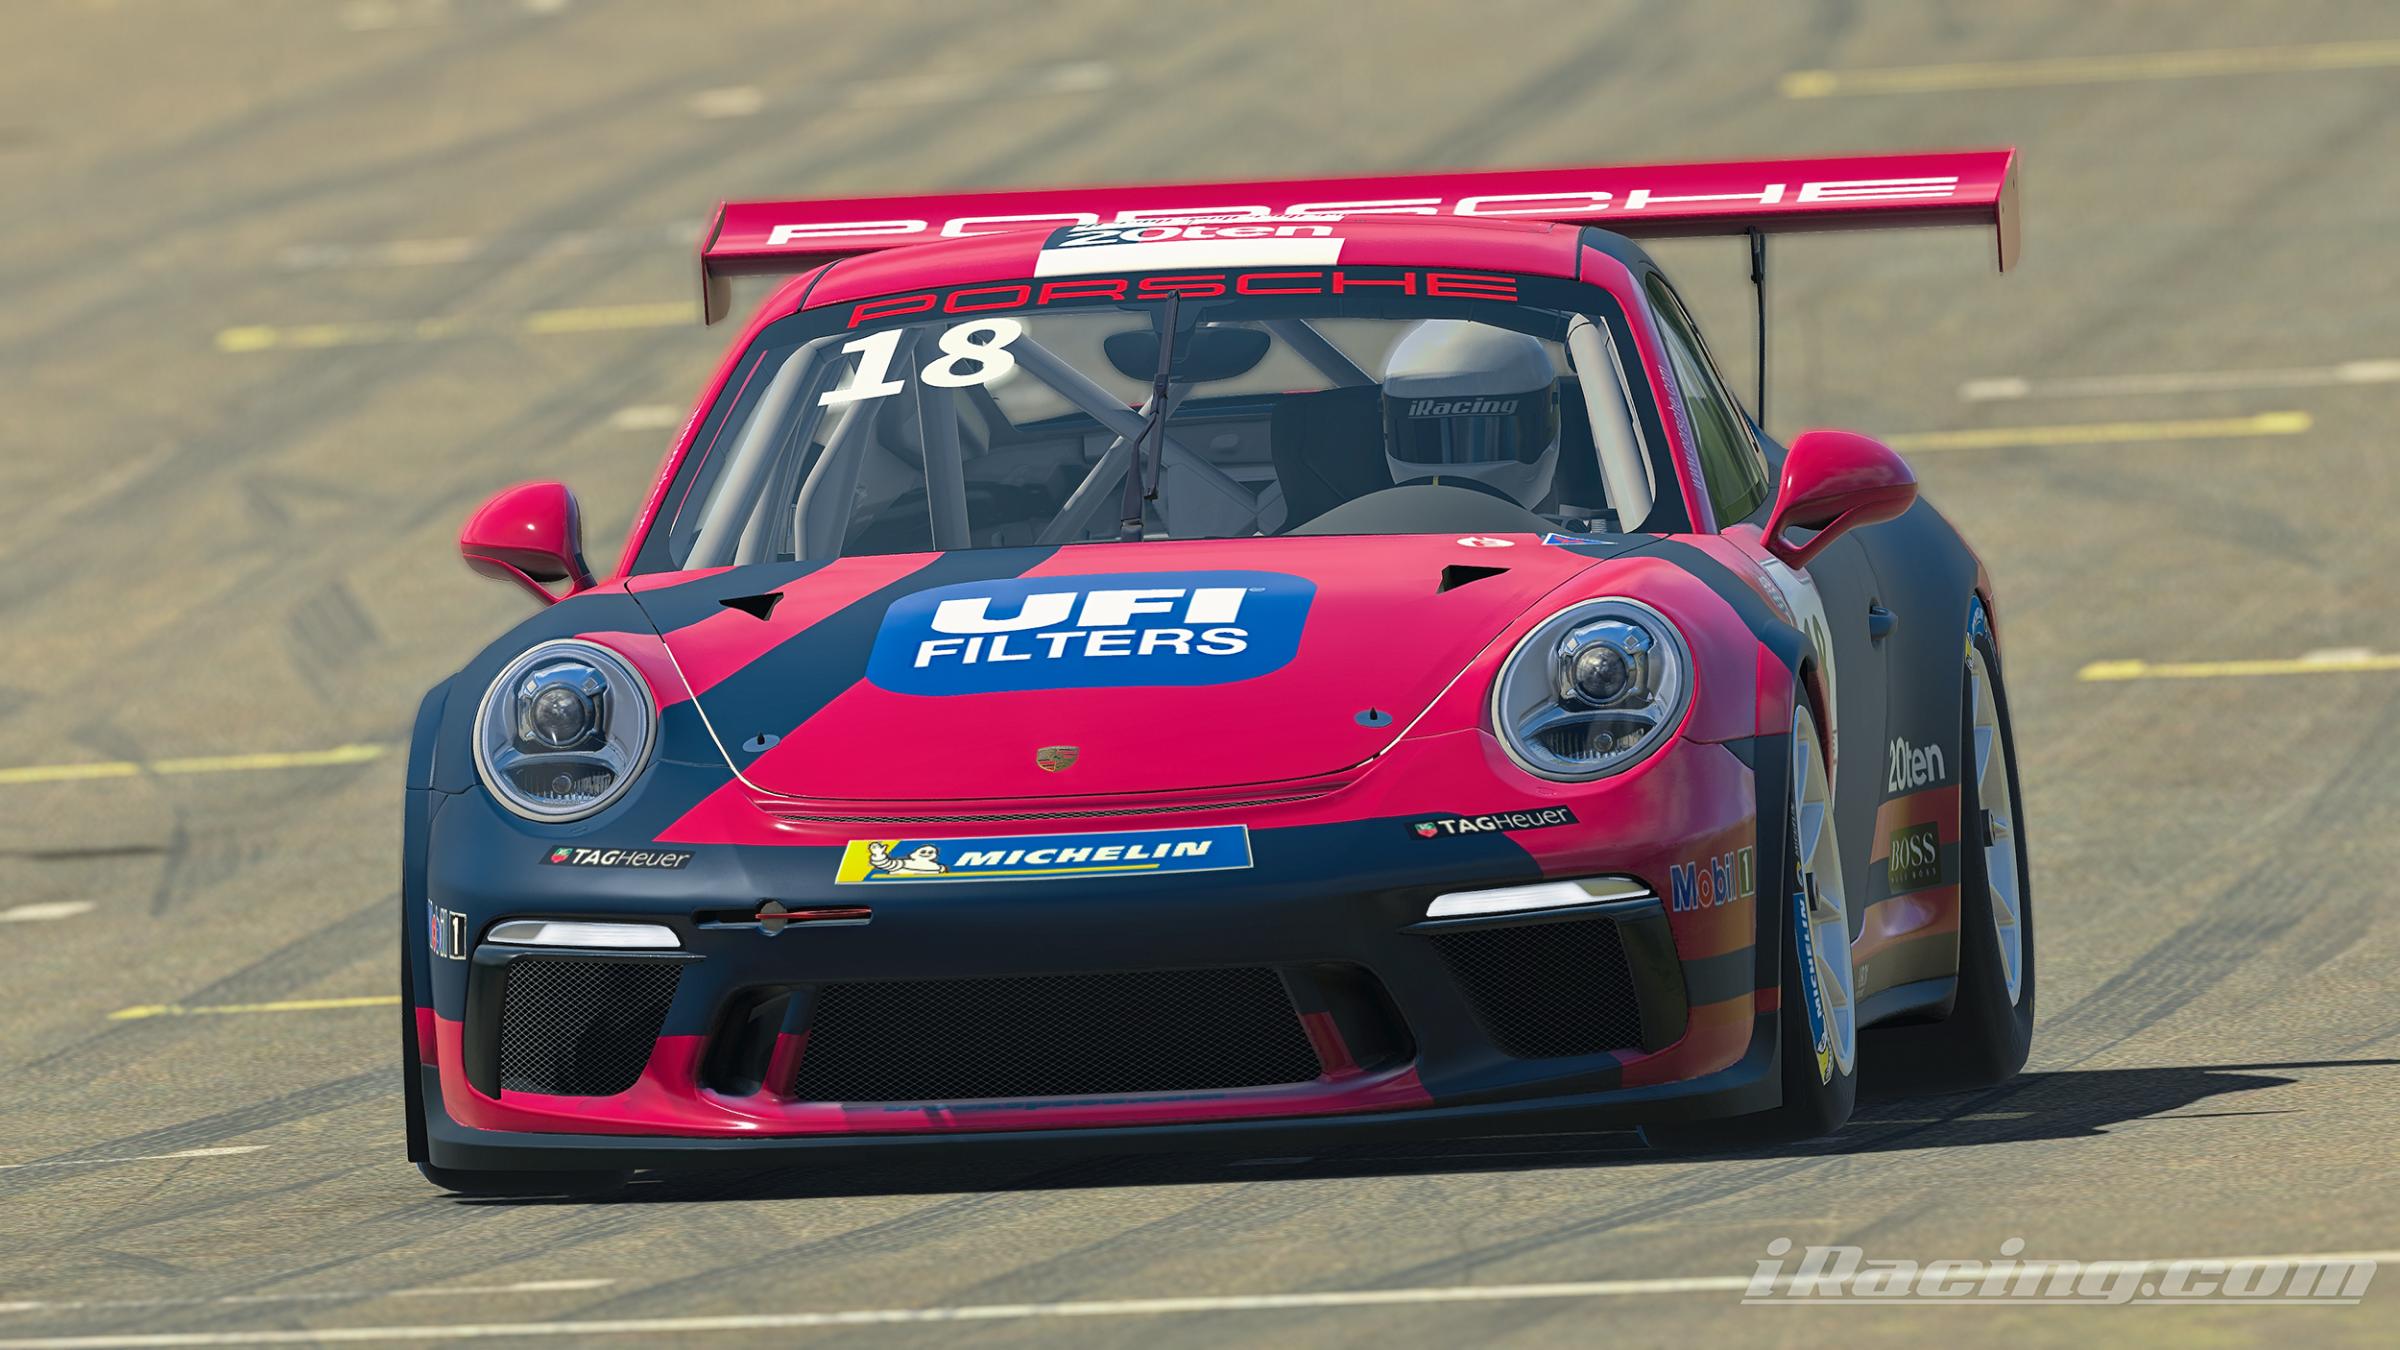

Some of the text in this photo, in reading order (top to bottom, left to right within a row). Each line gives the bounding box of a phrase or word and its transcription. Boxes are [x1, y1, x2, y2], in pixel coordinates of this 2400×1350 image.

[1058, 224, 1334, 248] 20ten
[846, 270, 1518, 329] PORSCHE
[817, 317, 1023, 408] 18
[1408, 397, 1518, 419] iRacing
[931, 587, 1248, 636] UFI
[913, 628, 1249, 669] FILTERS
[1887, 735, 1946, 794] 20ten
[953, 837, 1213, 868] MICHELIN
[1891, 831, 1936, 873] BOSS
[1669, 845, 1755, 913] Mobil 1
[448, 910, 467, 960] 1
[1799, 899, 1823, 1019] MICHELIN
